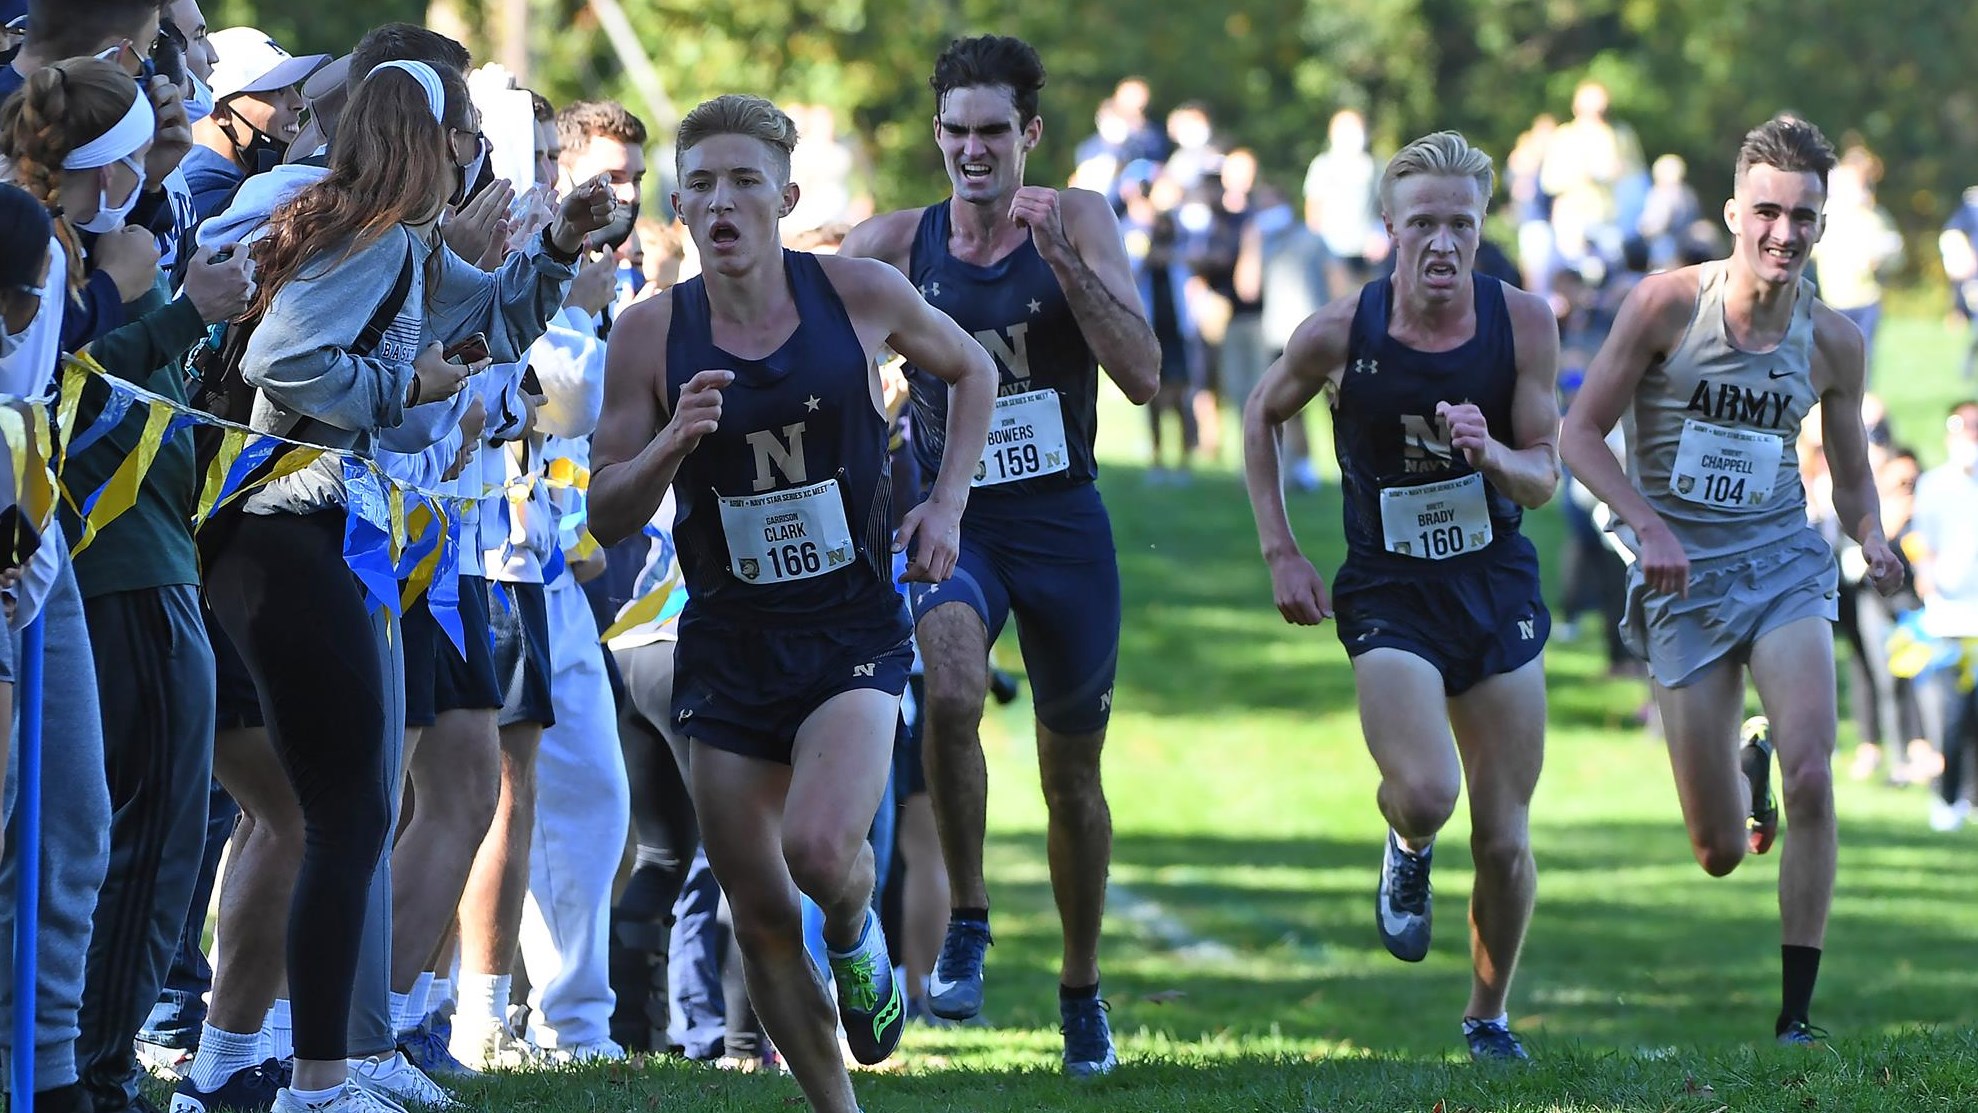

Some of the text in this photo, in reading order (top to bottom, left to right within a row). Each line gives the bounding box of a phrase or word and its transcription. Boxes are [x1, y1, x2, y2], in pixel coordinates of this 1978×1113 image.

[973, 322, 1031, 383] N
[999, 380, 1031, 398] AVY
[1686, 379, 1794, 429] ARMY
[987, 424, 1035, 446] BOWERS
[1401, 414, 1452, 459] N
[745, 421, 807, 492] N
[993, 443, 1040, 479] 159
[1045, 450, 1061, 469] N
[1701, 454, 1753, 474] CHAPPELL
[750, 498, 766, 507] NAVY
[766, 495, 783, 505] STAR
[782, 492, 803, 502] SERIES
[803, 490, 812, 499] XC
[812, 485, 828, 495] MEET
[1704, 473, 1746, 505] 104
[1748, 491, 1764, 505] N
[766, 512, 799, 526] GARRISON
[1417, 508, 1455, 527] BRADY
[764, 522, 807, 543] CLARK
[1419, 525, 1464, 558] 160
[1469, 531, 1485, 547] N
[767, 541, 821, 578] 166
[826, 548, 845, 566] N
[1517, 620, 1535, 640] N
[853, 663, 876, 677] N
